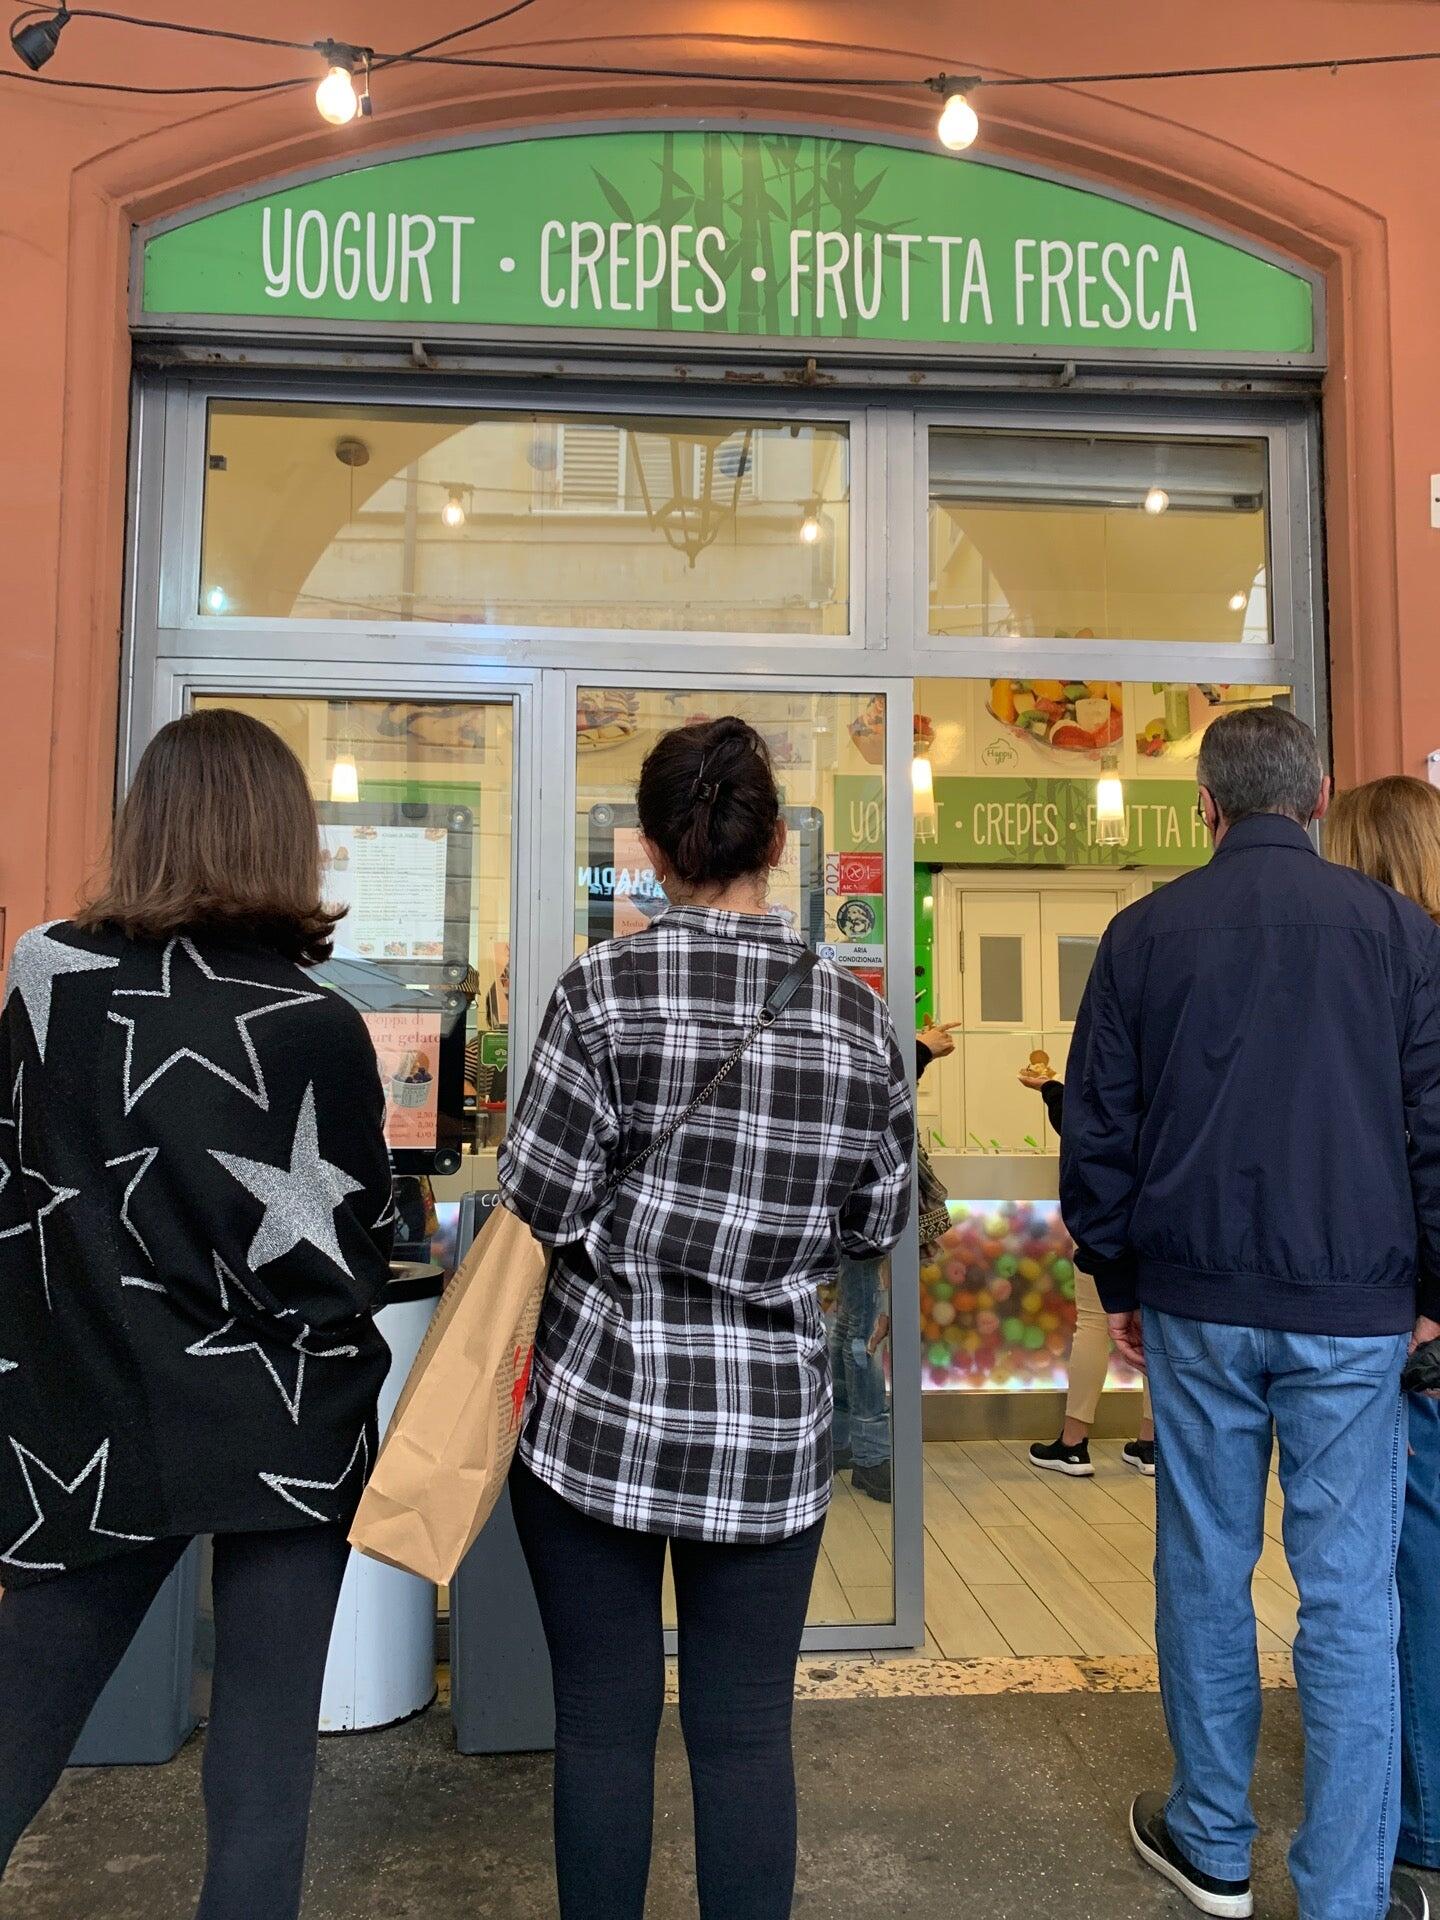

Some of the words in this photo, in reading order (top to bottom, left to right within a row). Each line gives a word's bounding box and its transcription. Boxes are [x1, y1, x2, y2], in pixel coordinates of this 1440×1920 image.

[263, 206, 476, 305] YOGURT
[539, 219, 727, 314] CREPES
[789, 229, 994, 325] FRUTTA
[1014, 238, 1198, 332] FRESCA
[972, 801, 1059, 847] CREPES
[826, 853, 839, 895] 2021
[838, 955, 882, 964] CONDIZIONATA
[365, 1014, 407, 1029] Coppa
[411, 1013, 424, 1026] di
